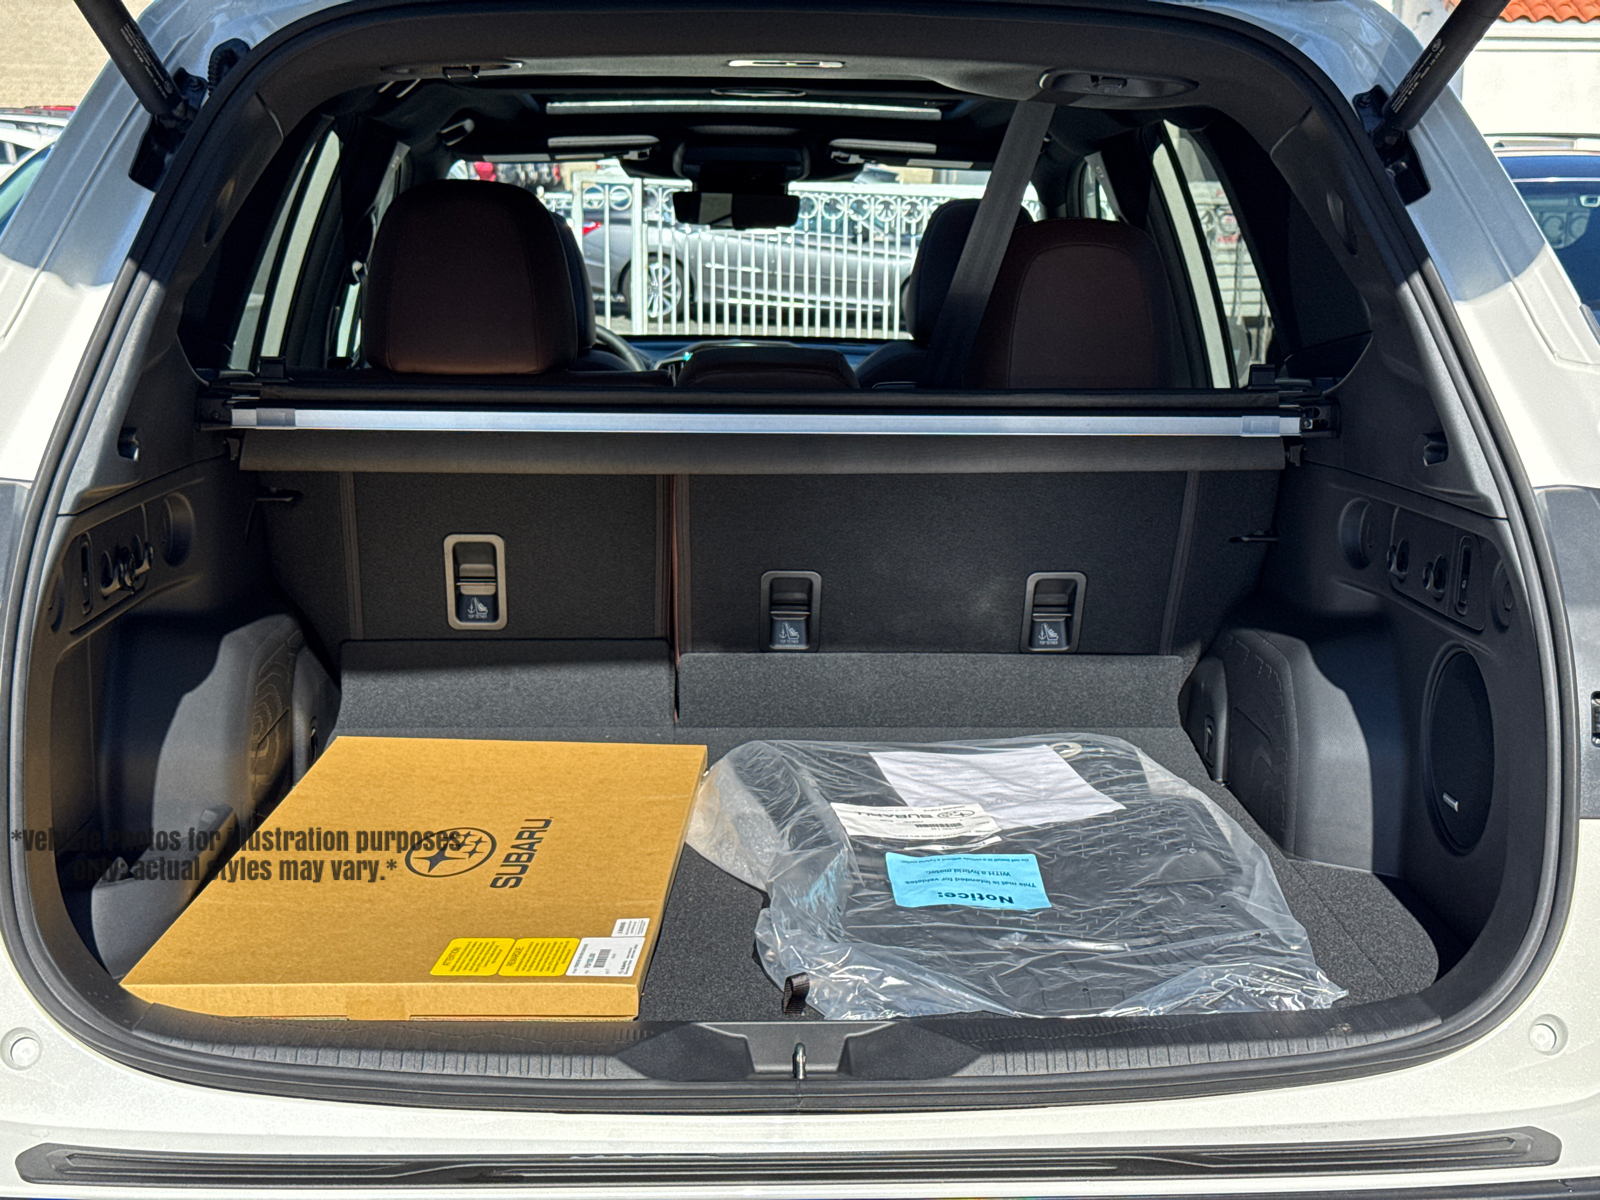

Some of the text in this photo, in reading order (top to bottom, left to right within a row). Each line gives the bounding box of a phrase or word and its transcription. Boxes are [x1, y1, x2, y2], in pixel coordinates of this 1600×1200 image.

[857, 811, 933, 819] SUBARU
[489, 818, 553, 889] SUBARU
[954, 868, 980, 876] hybrid
[905, 877, 940, 885] vehicles
[955, 877, 991, 885] intended
[937, 891, 1014, 904] Notice:
